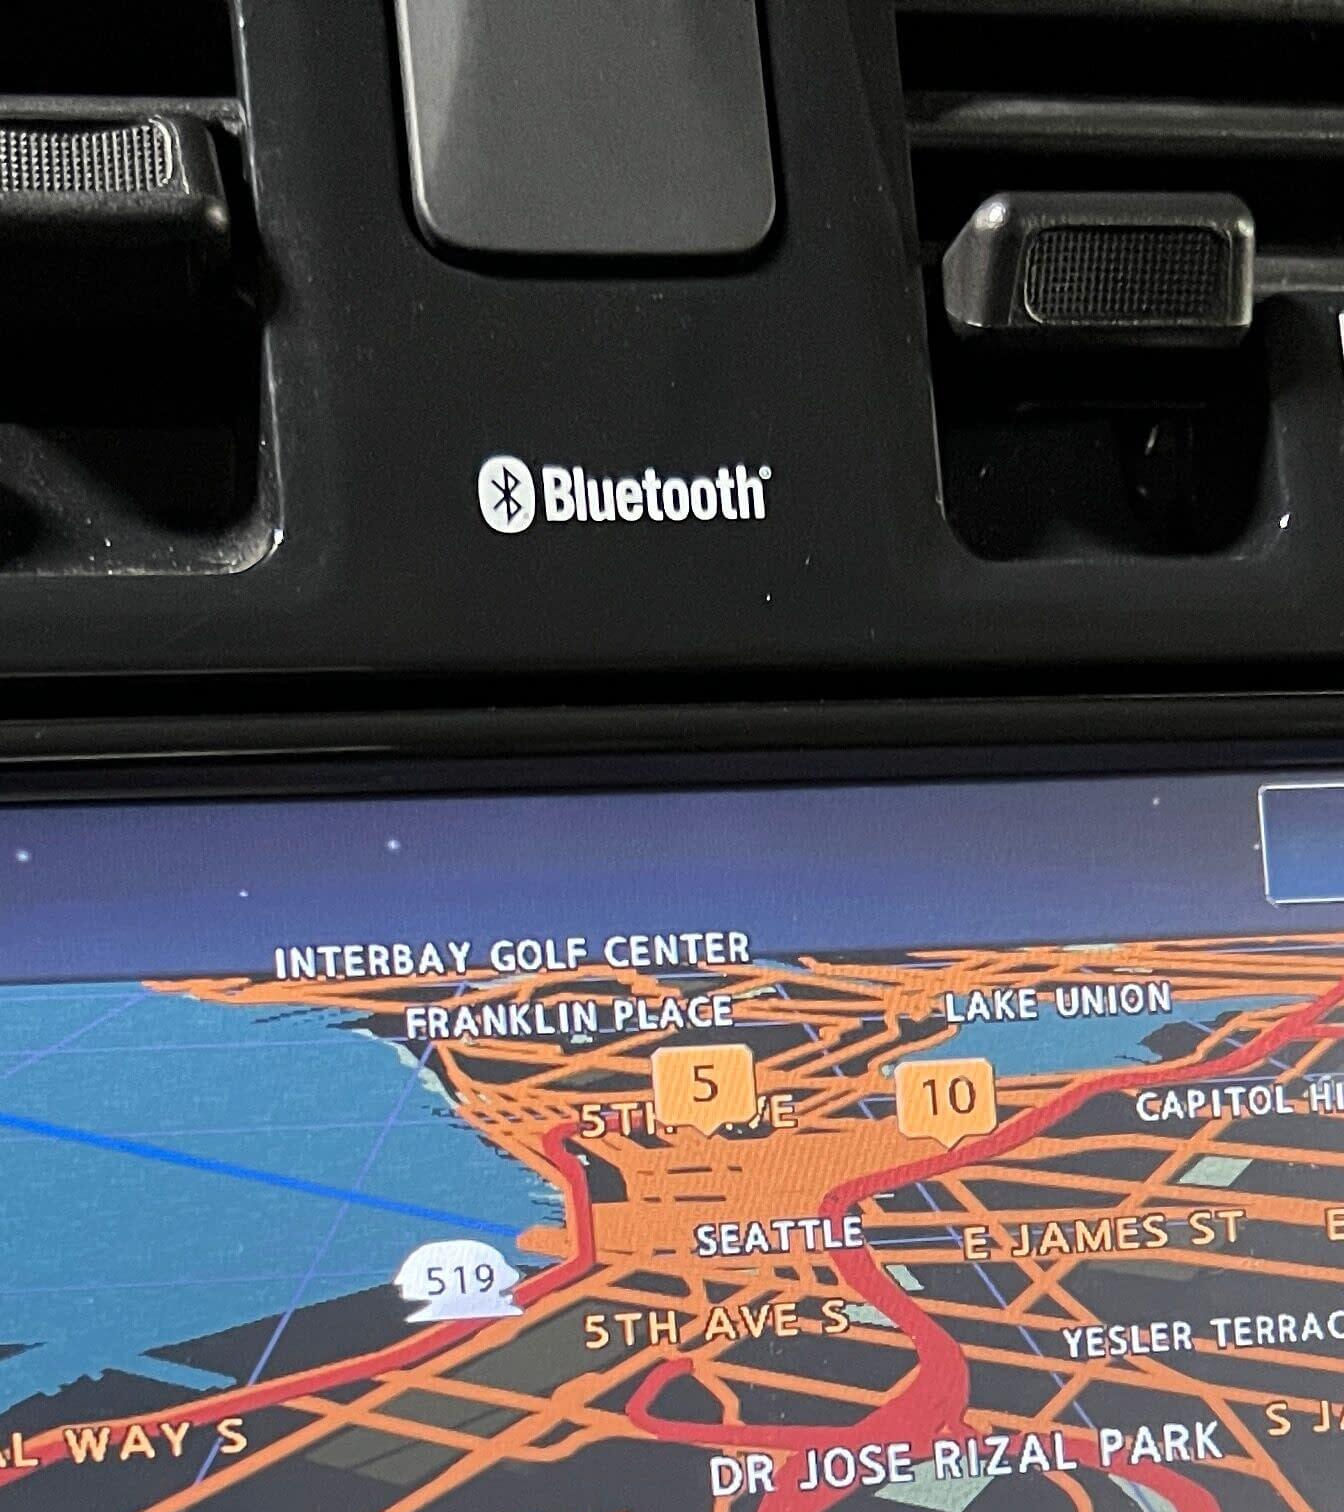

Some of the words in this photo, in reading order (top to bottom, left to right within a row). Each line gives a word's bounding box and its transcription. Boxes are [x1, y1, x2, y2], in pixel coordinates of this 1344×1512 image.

[274, 942, 471, 980] INTERBAY
[490, 937, 588, 973] GOLF
[603, 931, 750, 970] CENTER
[406, 1000, 598, 1039] FRANKLIN
[613, 995, 734, 1032] PLACE
[945, 988, 1038, 1023] LAKE
[1056, 981, 1172, 1018] UNION
[692, 1063, 719, 1103] 5
[922, 1076, 977, 1117] 10
[1136, 1084, 1294, 1122] CAPITOL
[695, 1216, 864, 1257] SEATTLE
[963, 1226, 990, 1261] E
[1011, 1215, 1169, 1257] JAMES
[1189, 1208, 1246, 1247] ST
[427, 1263, 495, 1296] 519
[585, 1311, 678, 1350] 5TH
[704, 1302, 799, 1342] AVE
[822, 1298, 850, 1334] S
[1062, 1320, 1194, 1360] YESLER
[1265, 1402, 1292, 1436] S
[62, 1420, 193, 1464] WAY
[216, 1417, 247, 1455] S
[709, 1457, 775, 1498] DR
[799, 1443, 915, 1491] JOSE
[934, 1431, 1078, 1479] RIZAL
[1099, 1420, 1223, 1467] PARK
